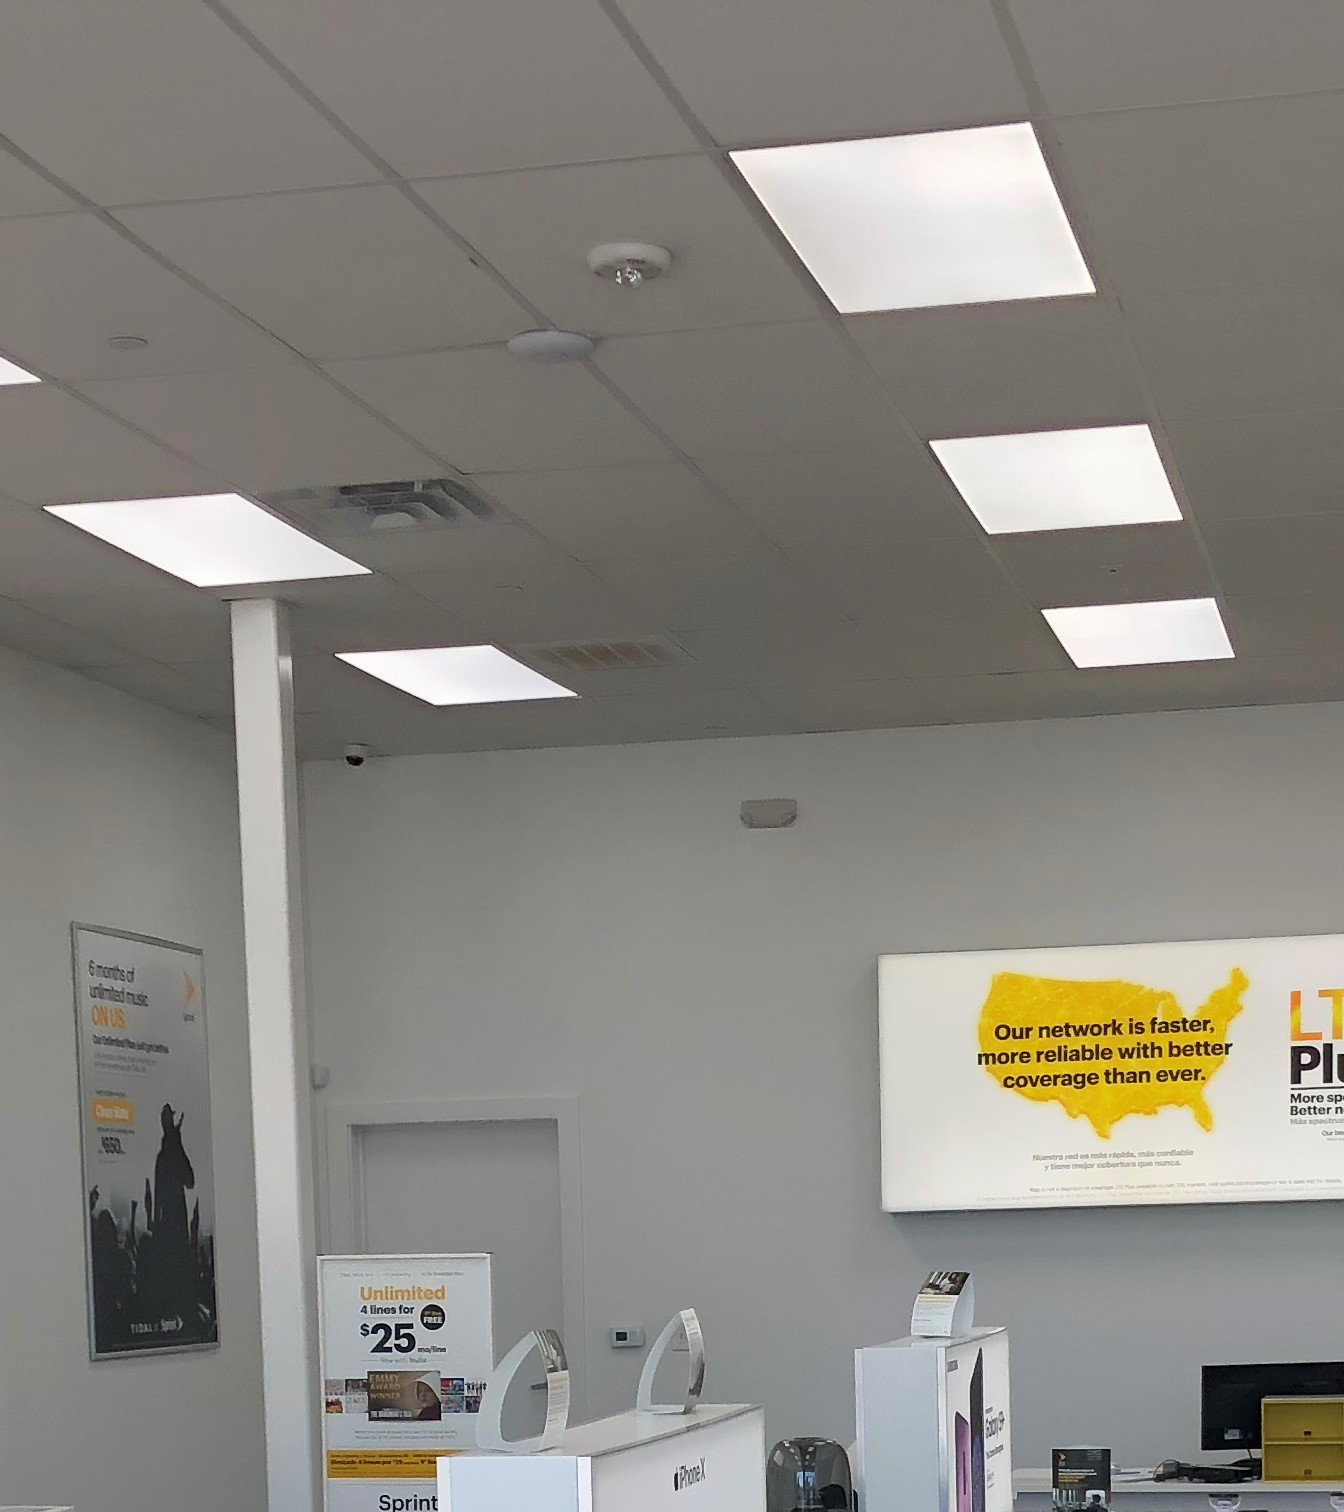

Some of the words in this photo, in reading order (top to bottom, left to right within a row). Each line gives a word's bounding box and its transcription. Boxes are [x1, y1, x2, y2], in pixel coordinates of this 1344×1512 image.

[994, 1023, 1033, 1041] Our
[1038, 1019, 1123, 1039] network
[1128, 1018, 1145, 1035] is
[1149, 1017, 1215, 1034] faster,
[977, 1048, 1031, 1066] more
[1036, 1044, 1113, 1063] reliable
[1117, 1041, 1163, 1060] with
[1168, 1040, 1234, 1058] better
[1003, 1072, 1100, 1090] coverage
[1103, 1068, 1151, 1085] than
[1155, 1066, 1207, 1083] ever.
[1290, 1093, 1324, 1104] More
[1290, 1105, 1332, 1116] Better
[360, 1284, 446, 1301] Unlimited
[360, 1305, 368, 1315] 4
[370, 1304, 396, 1315] lines
[398, 1304, 415, 1315] for
[423, 1316, 443, 1324] FREE
[360, 1323, 416, 1354] $25
